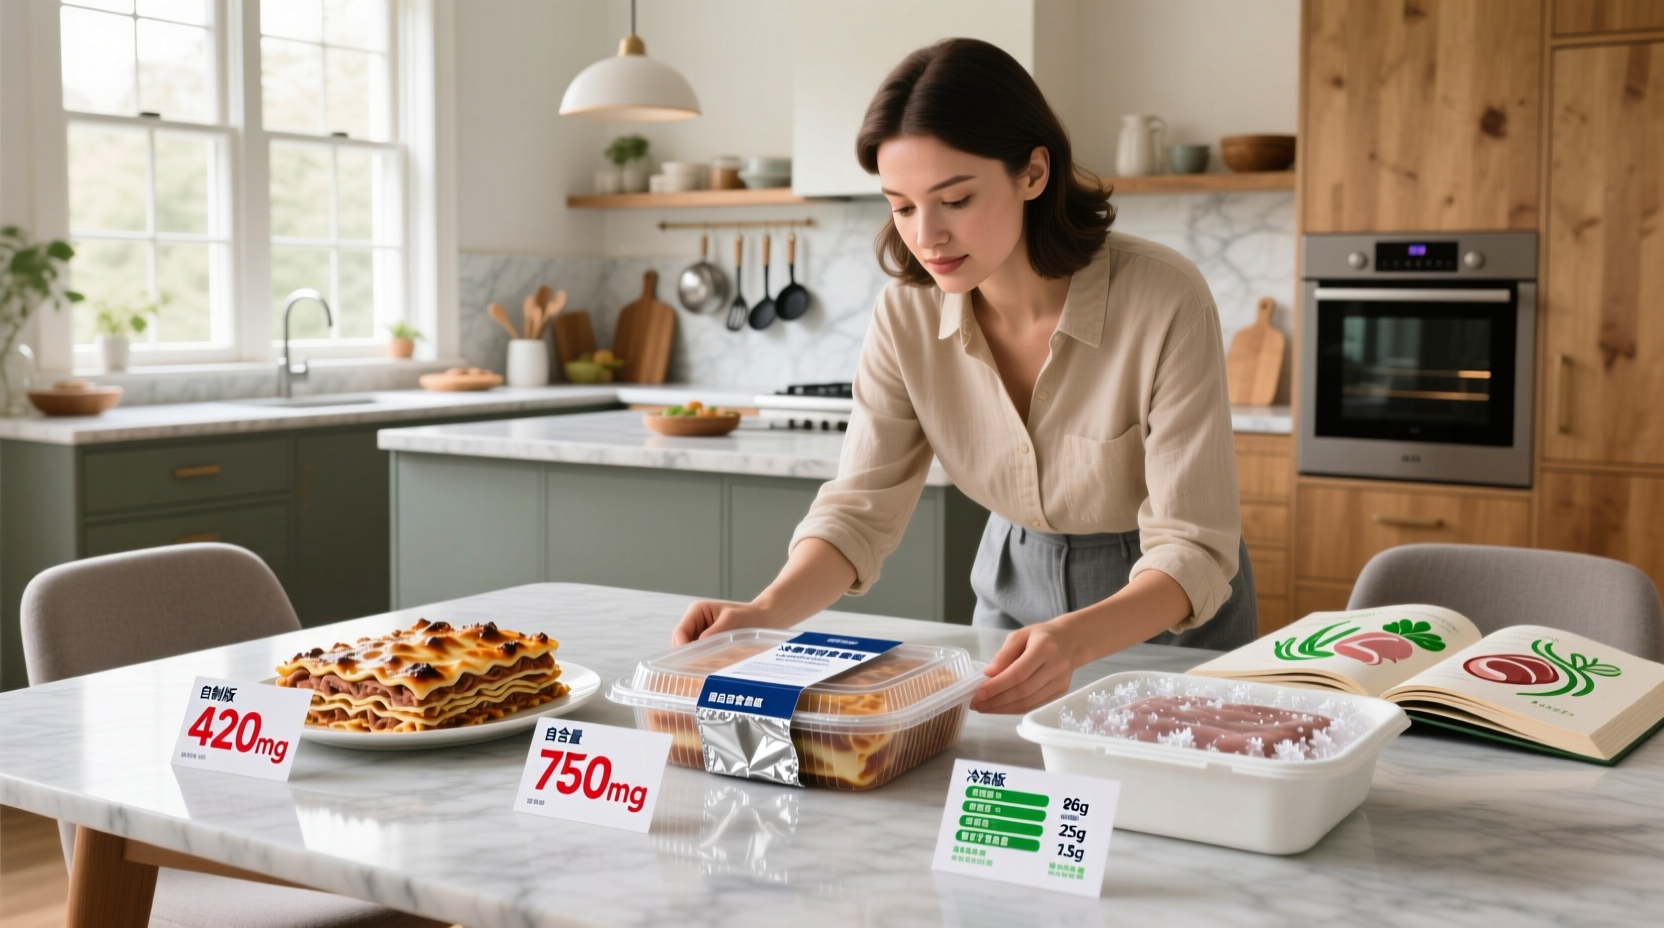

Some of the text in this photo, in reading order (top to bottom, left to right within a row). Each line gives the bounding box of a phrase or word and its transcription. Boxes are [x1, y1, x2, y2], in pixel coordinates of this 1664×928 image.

[200, 685, 238, 703] 自制版
[187, 705, 289, 765] 420mg
[535, 748, 648, 813] 750mg
[1063, 797, 1089, 816] 26g
[1058, 824, 1087, 843] 25g
